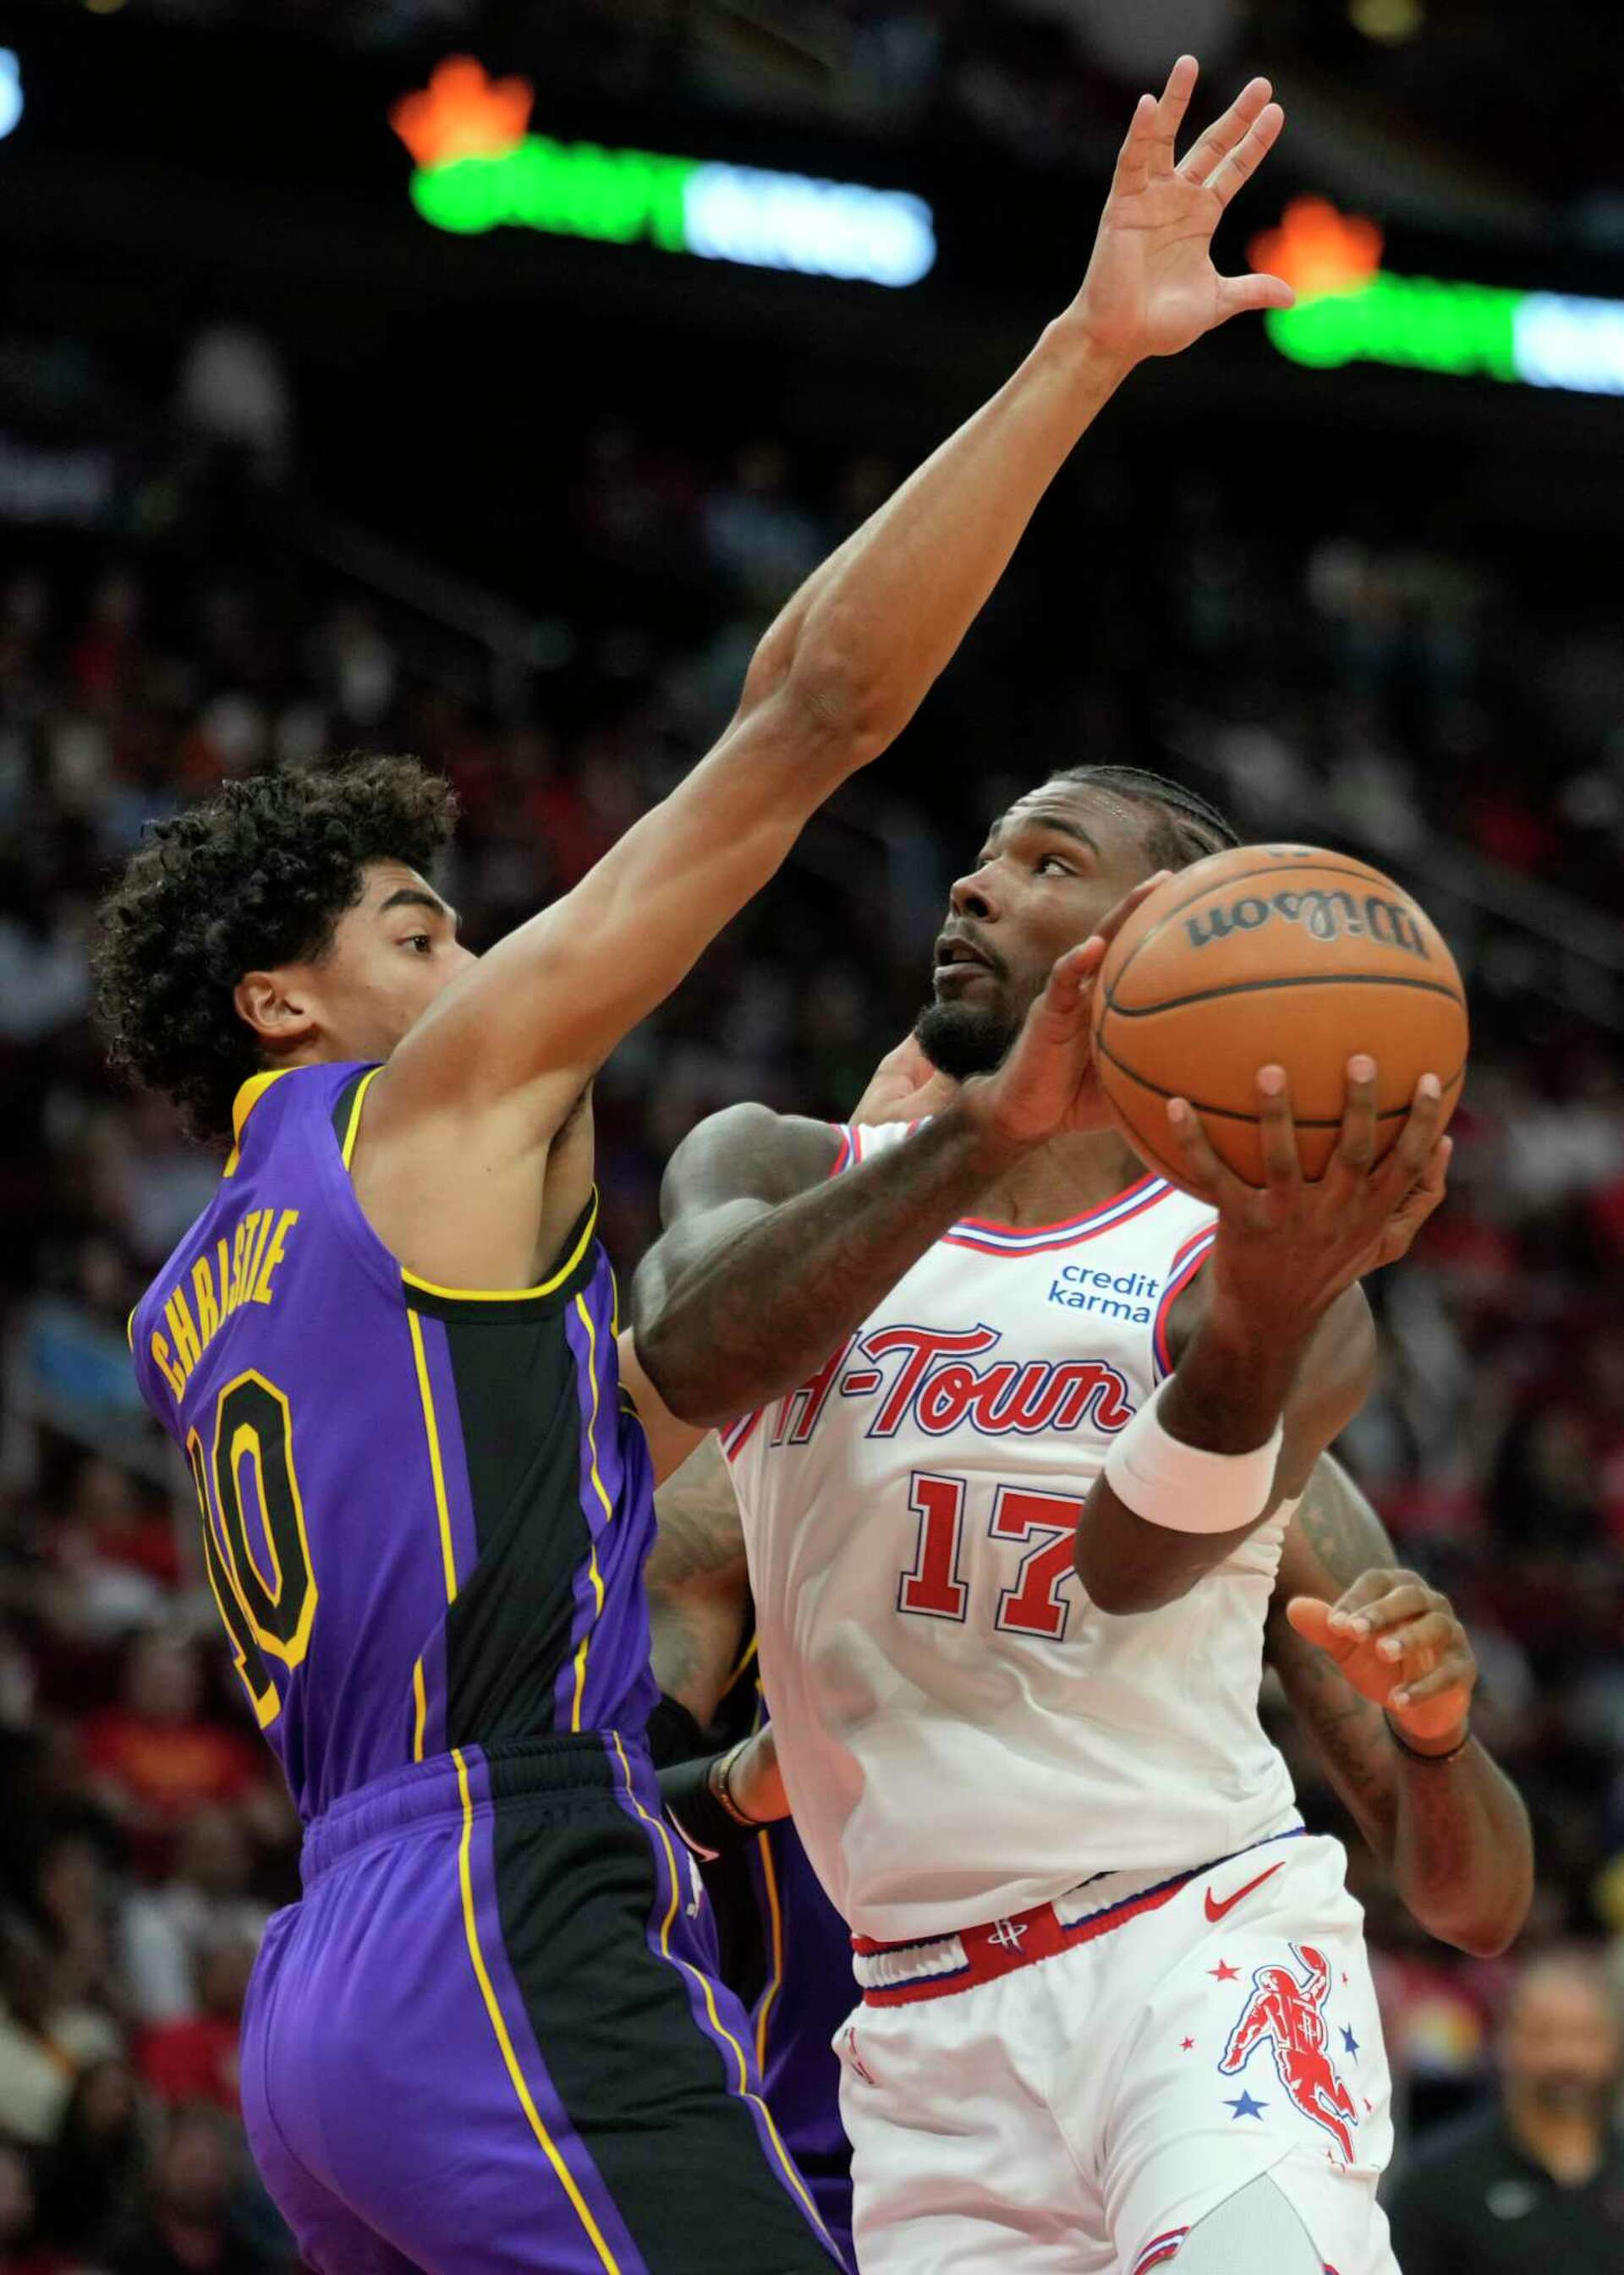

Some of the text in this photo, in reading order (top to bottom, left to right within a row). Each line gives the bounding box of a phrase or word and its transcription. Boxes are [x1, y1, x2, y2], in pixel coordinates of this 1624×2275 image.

[1187, 890, 1428, 959] Wilson
[151, 1209, 299, 1405] CHRISTIE
[1048, 1280, 1151, 1324] karma
[1062, 1265, 1159, 1298] credit
[187, 1368, 319, 1730] 10
[897, 1471, 1086, 1642] 17
